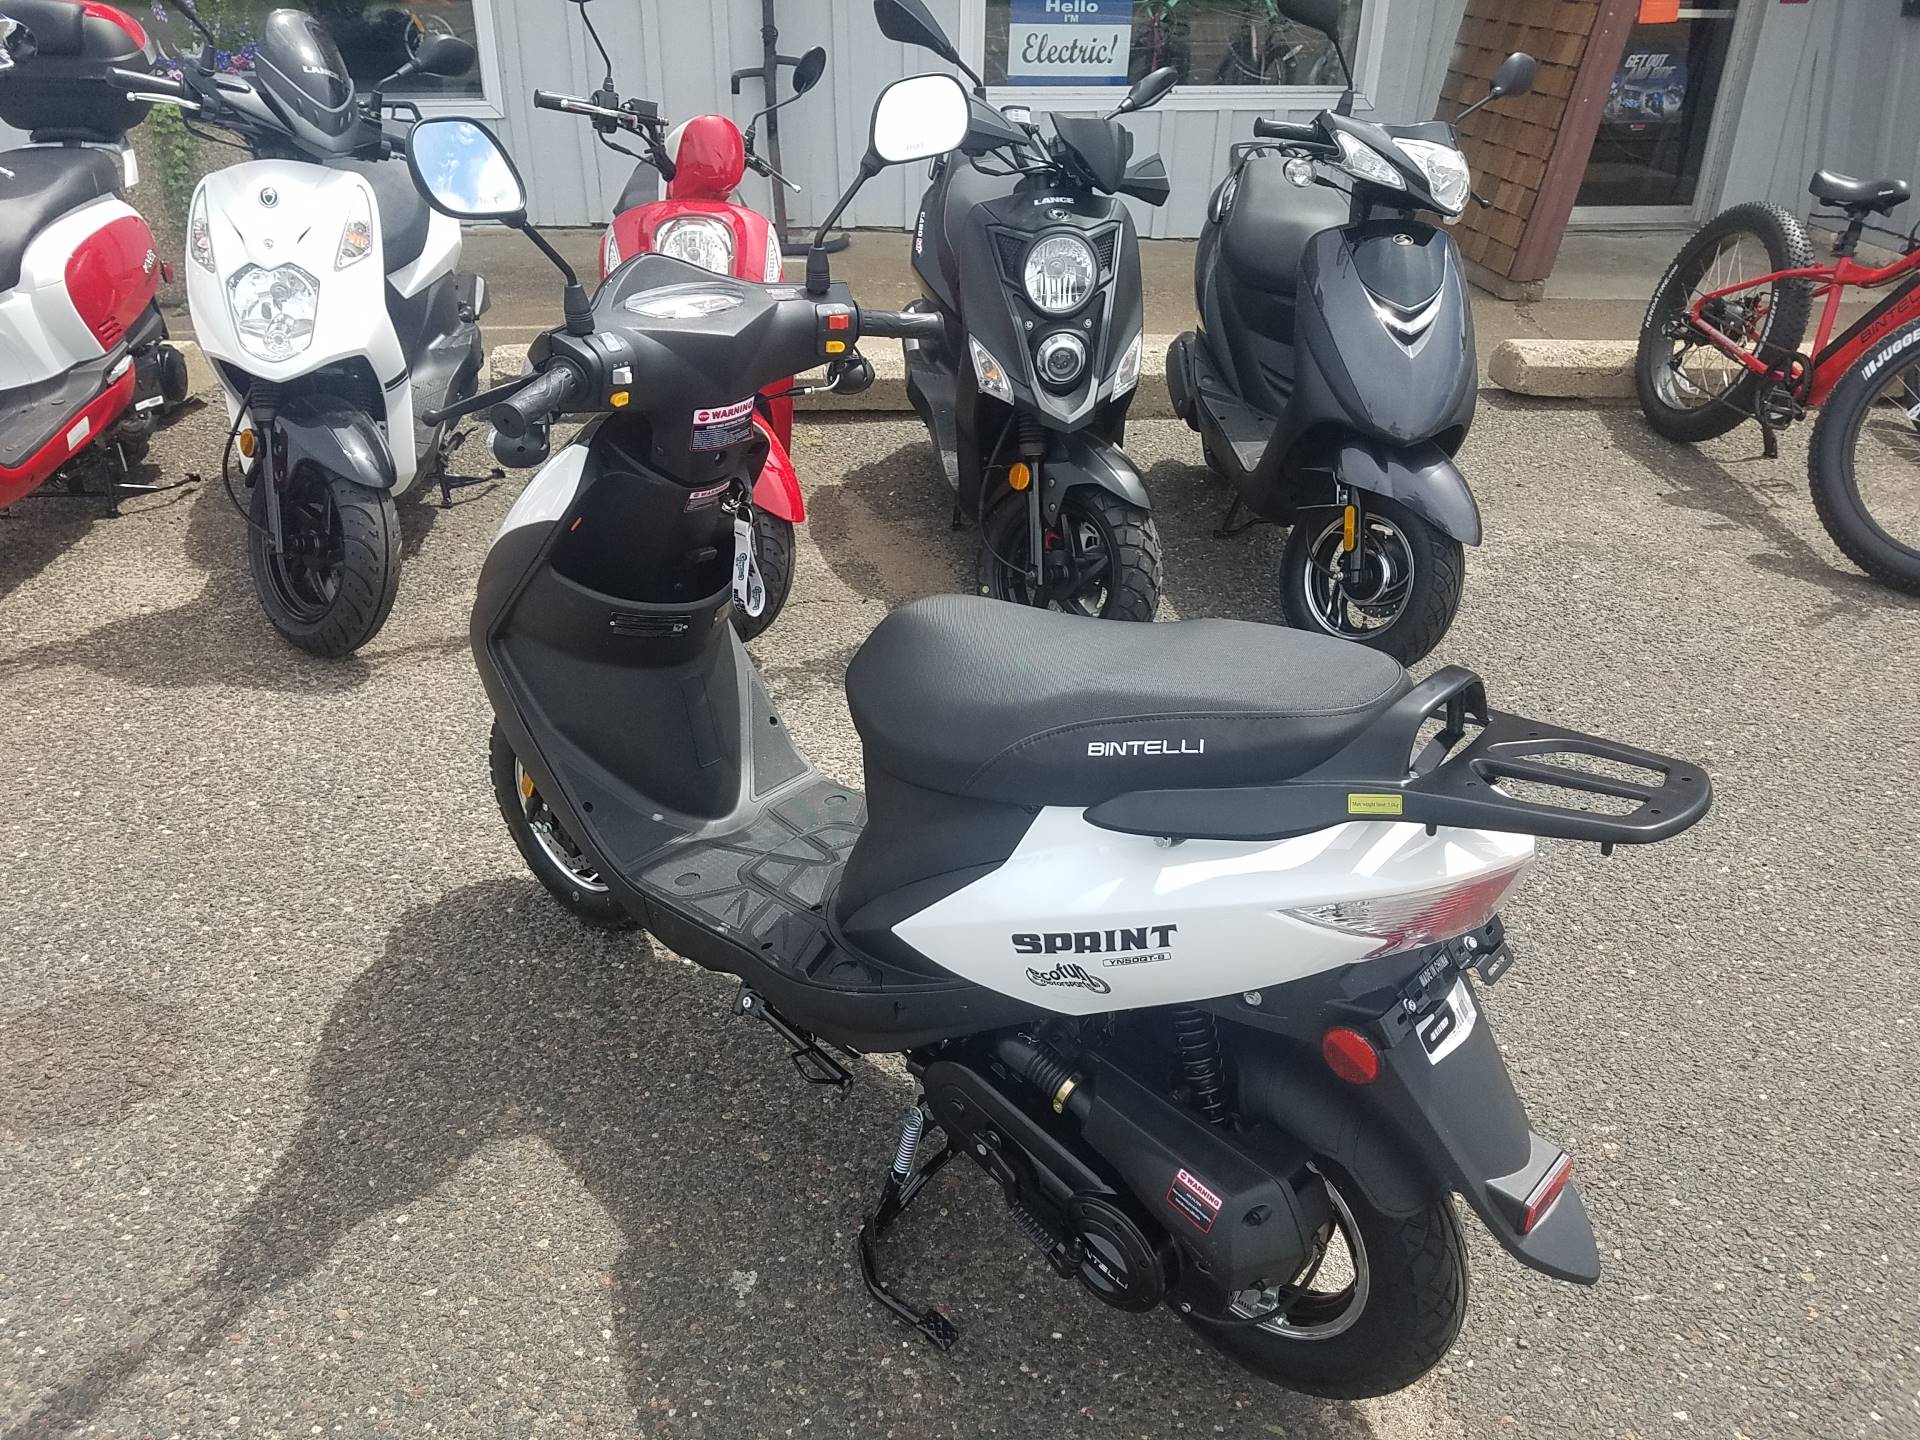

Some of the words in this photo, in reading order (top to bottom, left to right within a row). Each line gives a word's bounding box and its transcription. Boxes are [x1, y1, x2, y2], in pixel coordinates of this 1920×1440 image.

[1045, 0, 1099, 13] Hello
[1021, 32, 1118, 64] Electric!
[1624, 54, 1649, 68] GET
[1645, 54, 1670, 67] OUT
[1033, 196, 1074, 206] LANCE
[711, 400, 753, 420] WARNING
[1087, 739, 1205, 757] BINTELLI
[1011, 923, 1178, 954] SPRINT
[1187, 1177, 1220, 1208] WARNING
